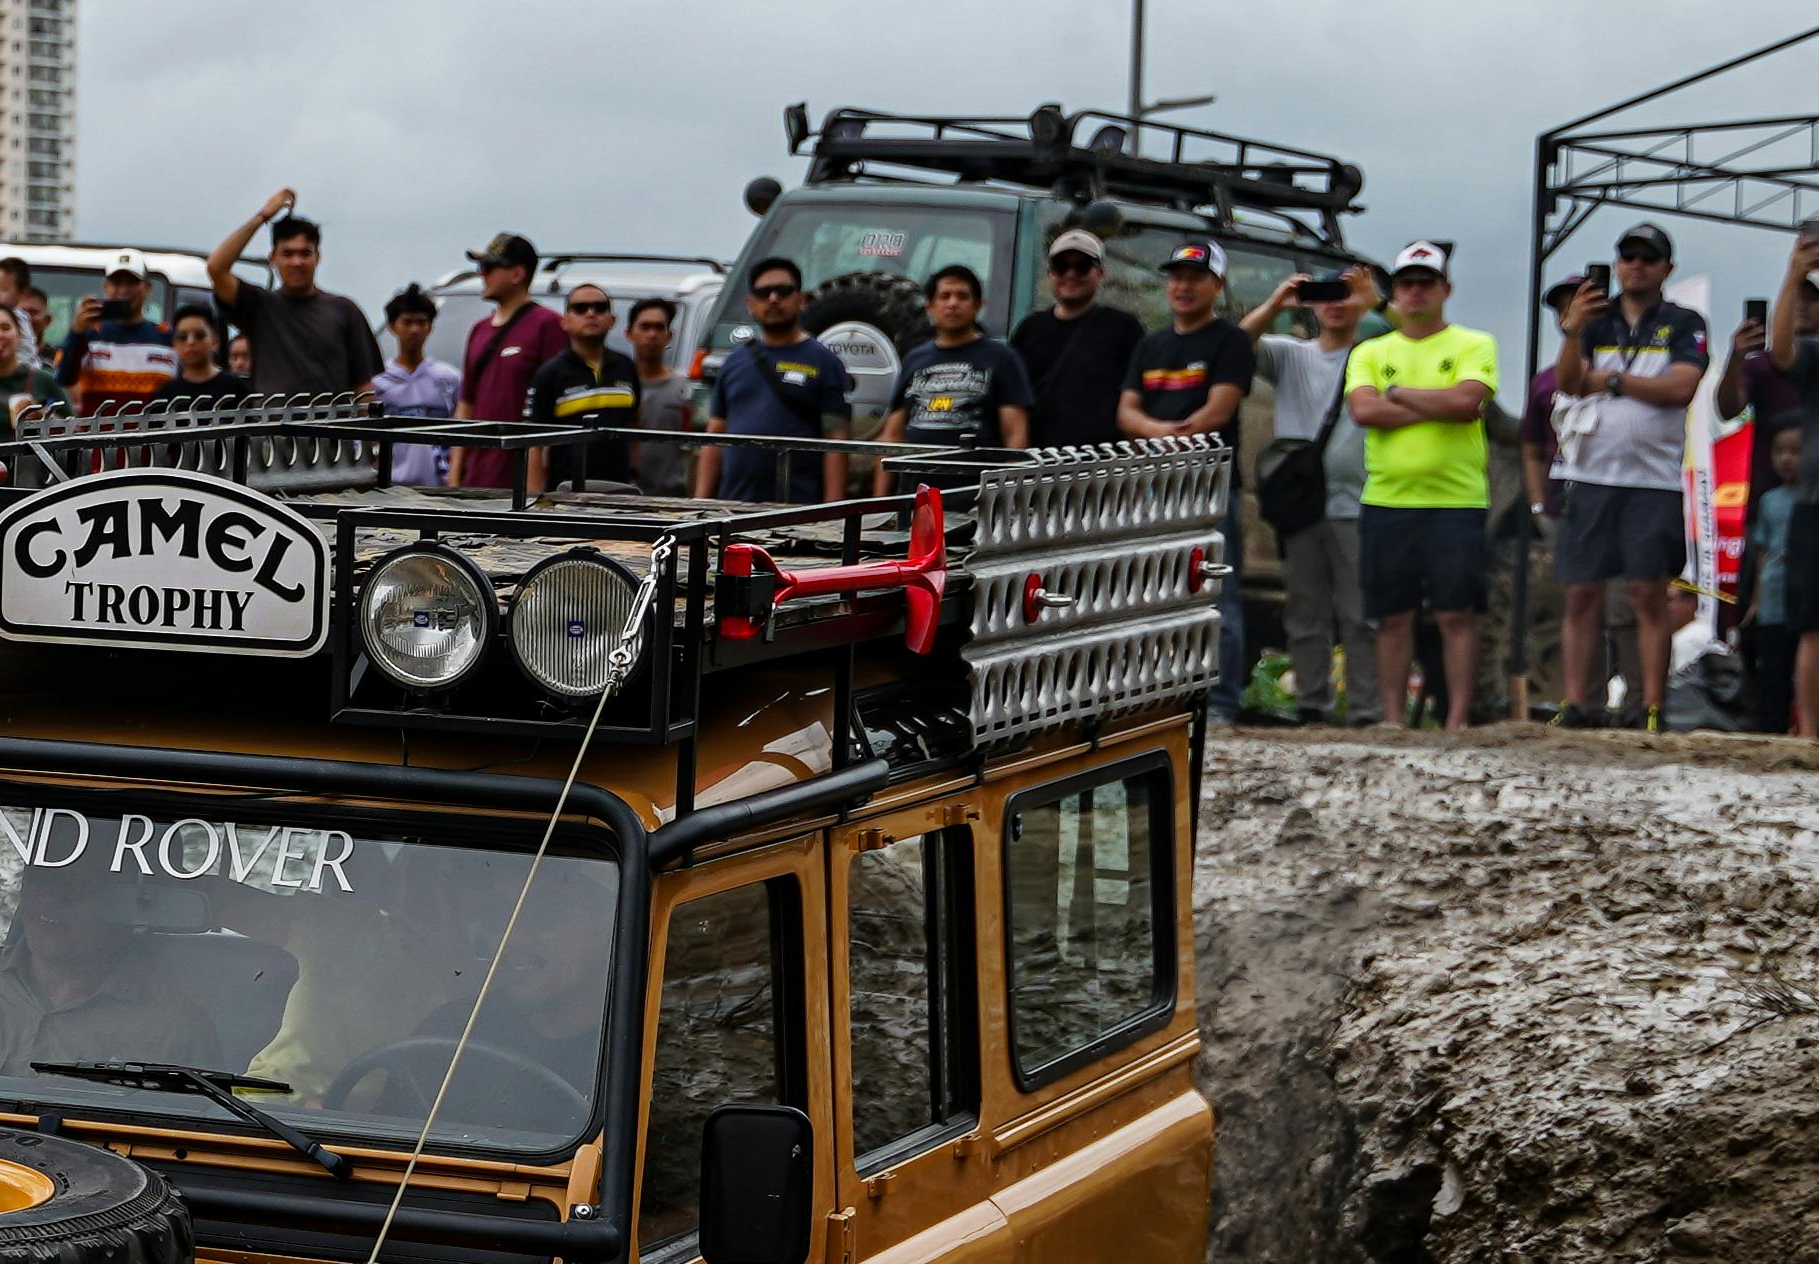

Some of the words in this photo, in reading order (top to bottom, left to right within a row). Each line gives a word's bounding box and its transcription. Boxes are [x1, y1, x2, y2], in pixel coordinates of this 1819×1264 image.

[828, 343, 875, 355] TOYOTA
[14, 498, 305, 603] CAMEL
[65, 580, 255, 631] TROPHY
[110, 814, 354, 893] ROVER
